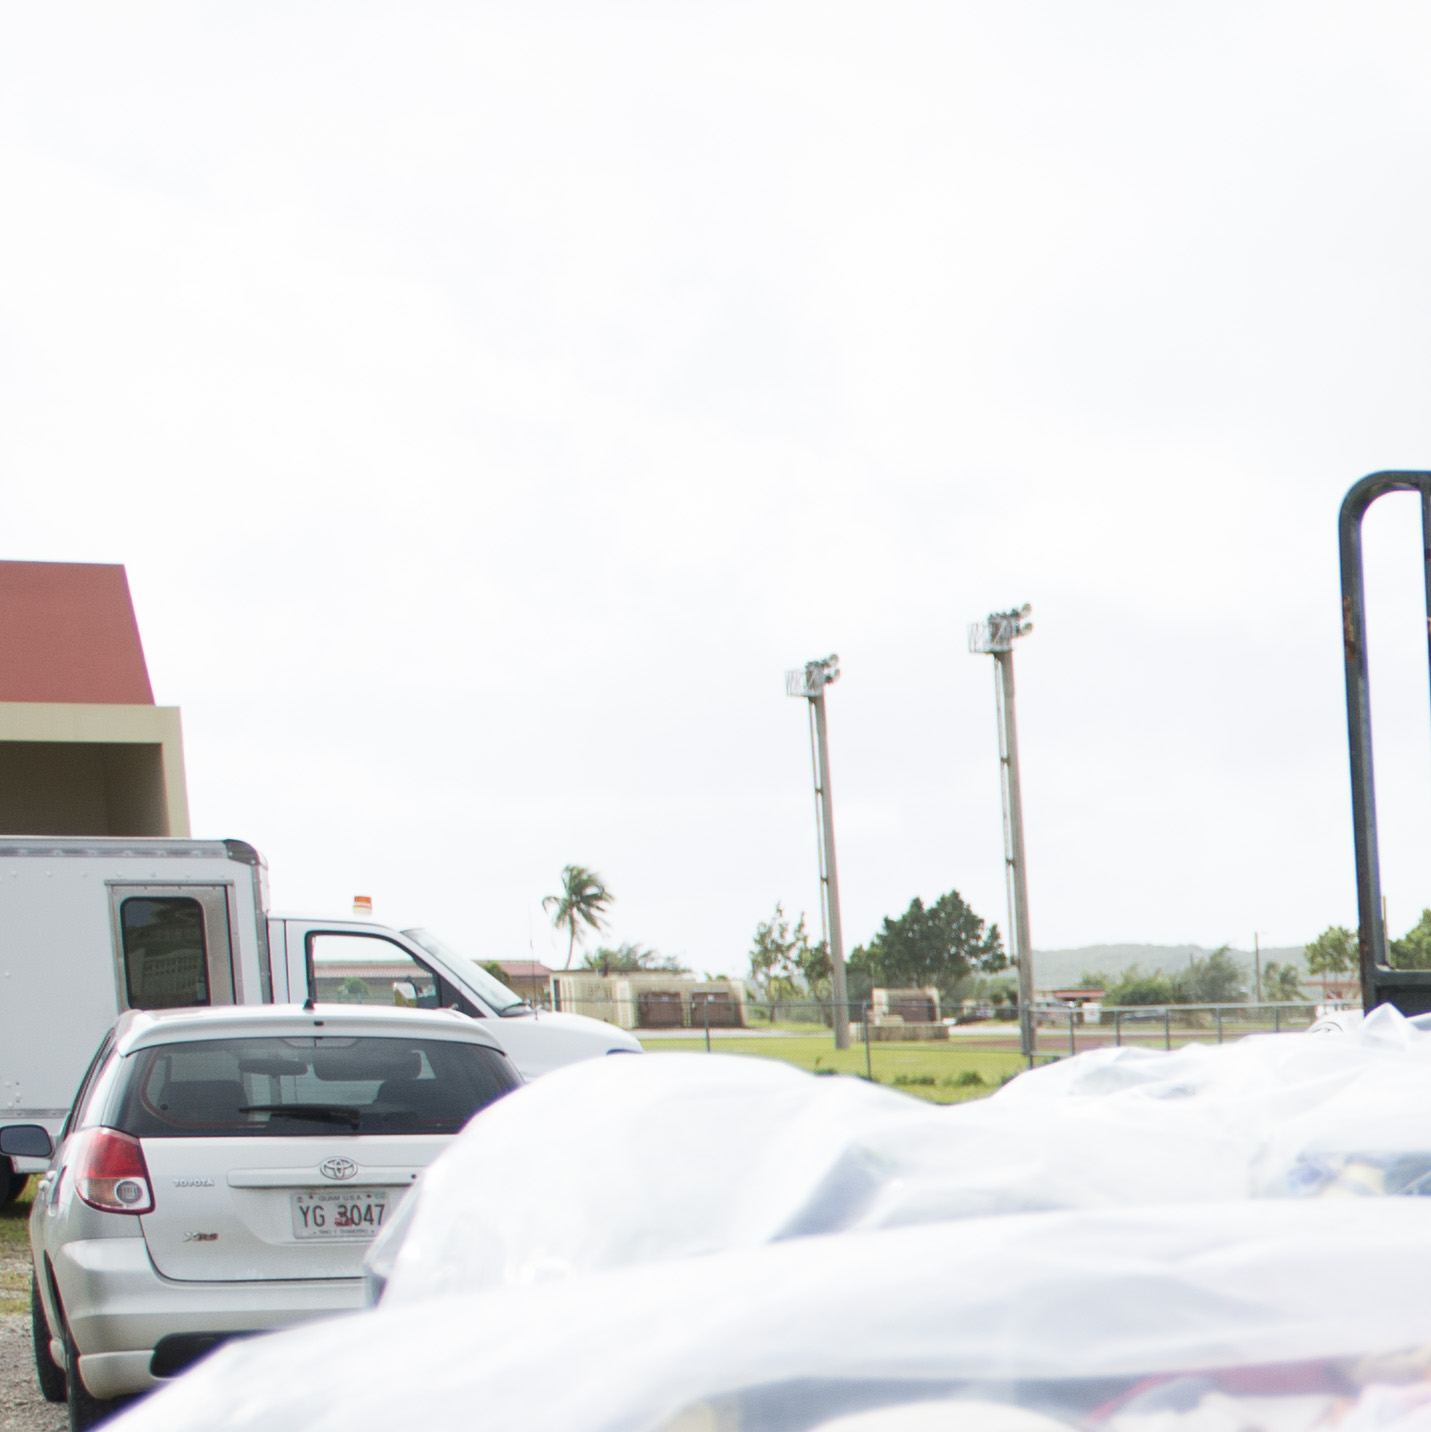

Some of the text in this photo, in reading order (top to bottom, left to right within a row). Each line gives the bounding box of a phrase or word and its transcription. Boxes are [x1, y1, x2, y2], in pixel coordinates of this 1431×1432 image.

[172, 1178, 215, 1188] TOYOTA
[298, 1203, 386, 1228] YG 3047
